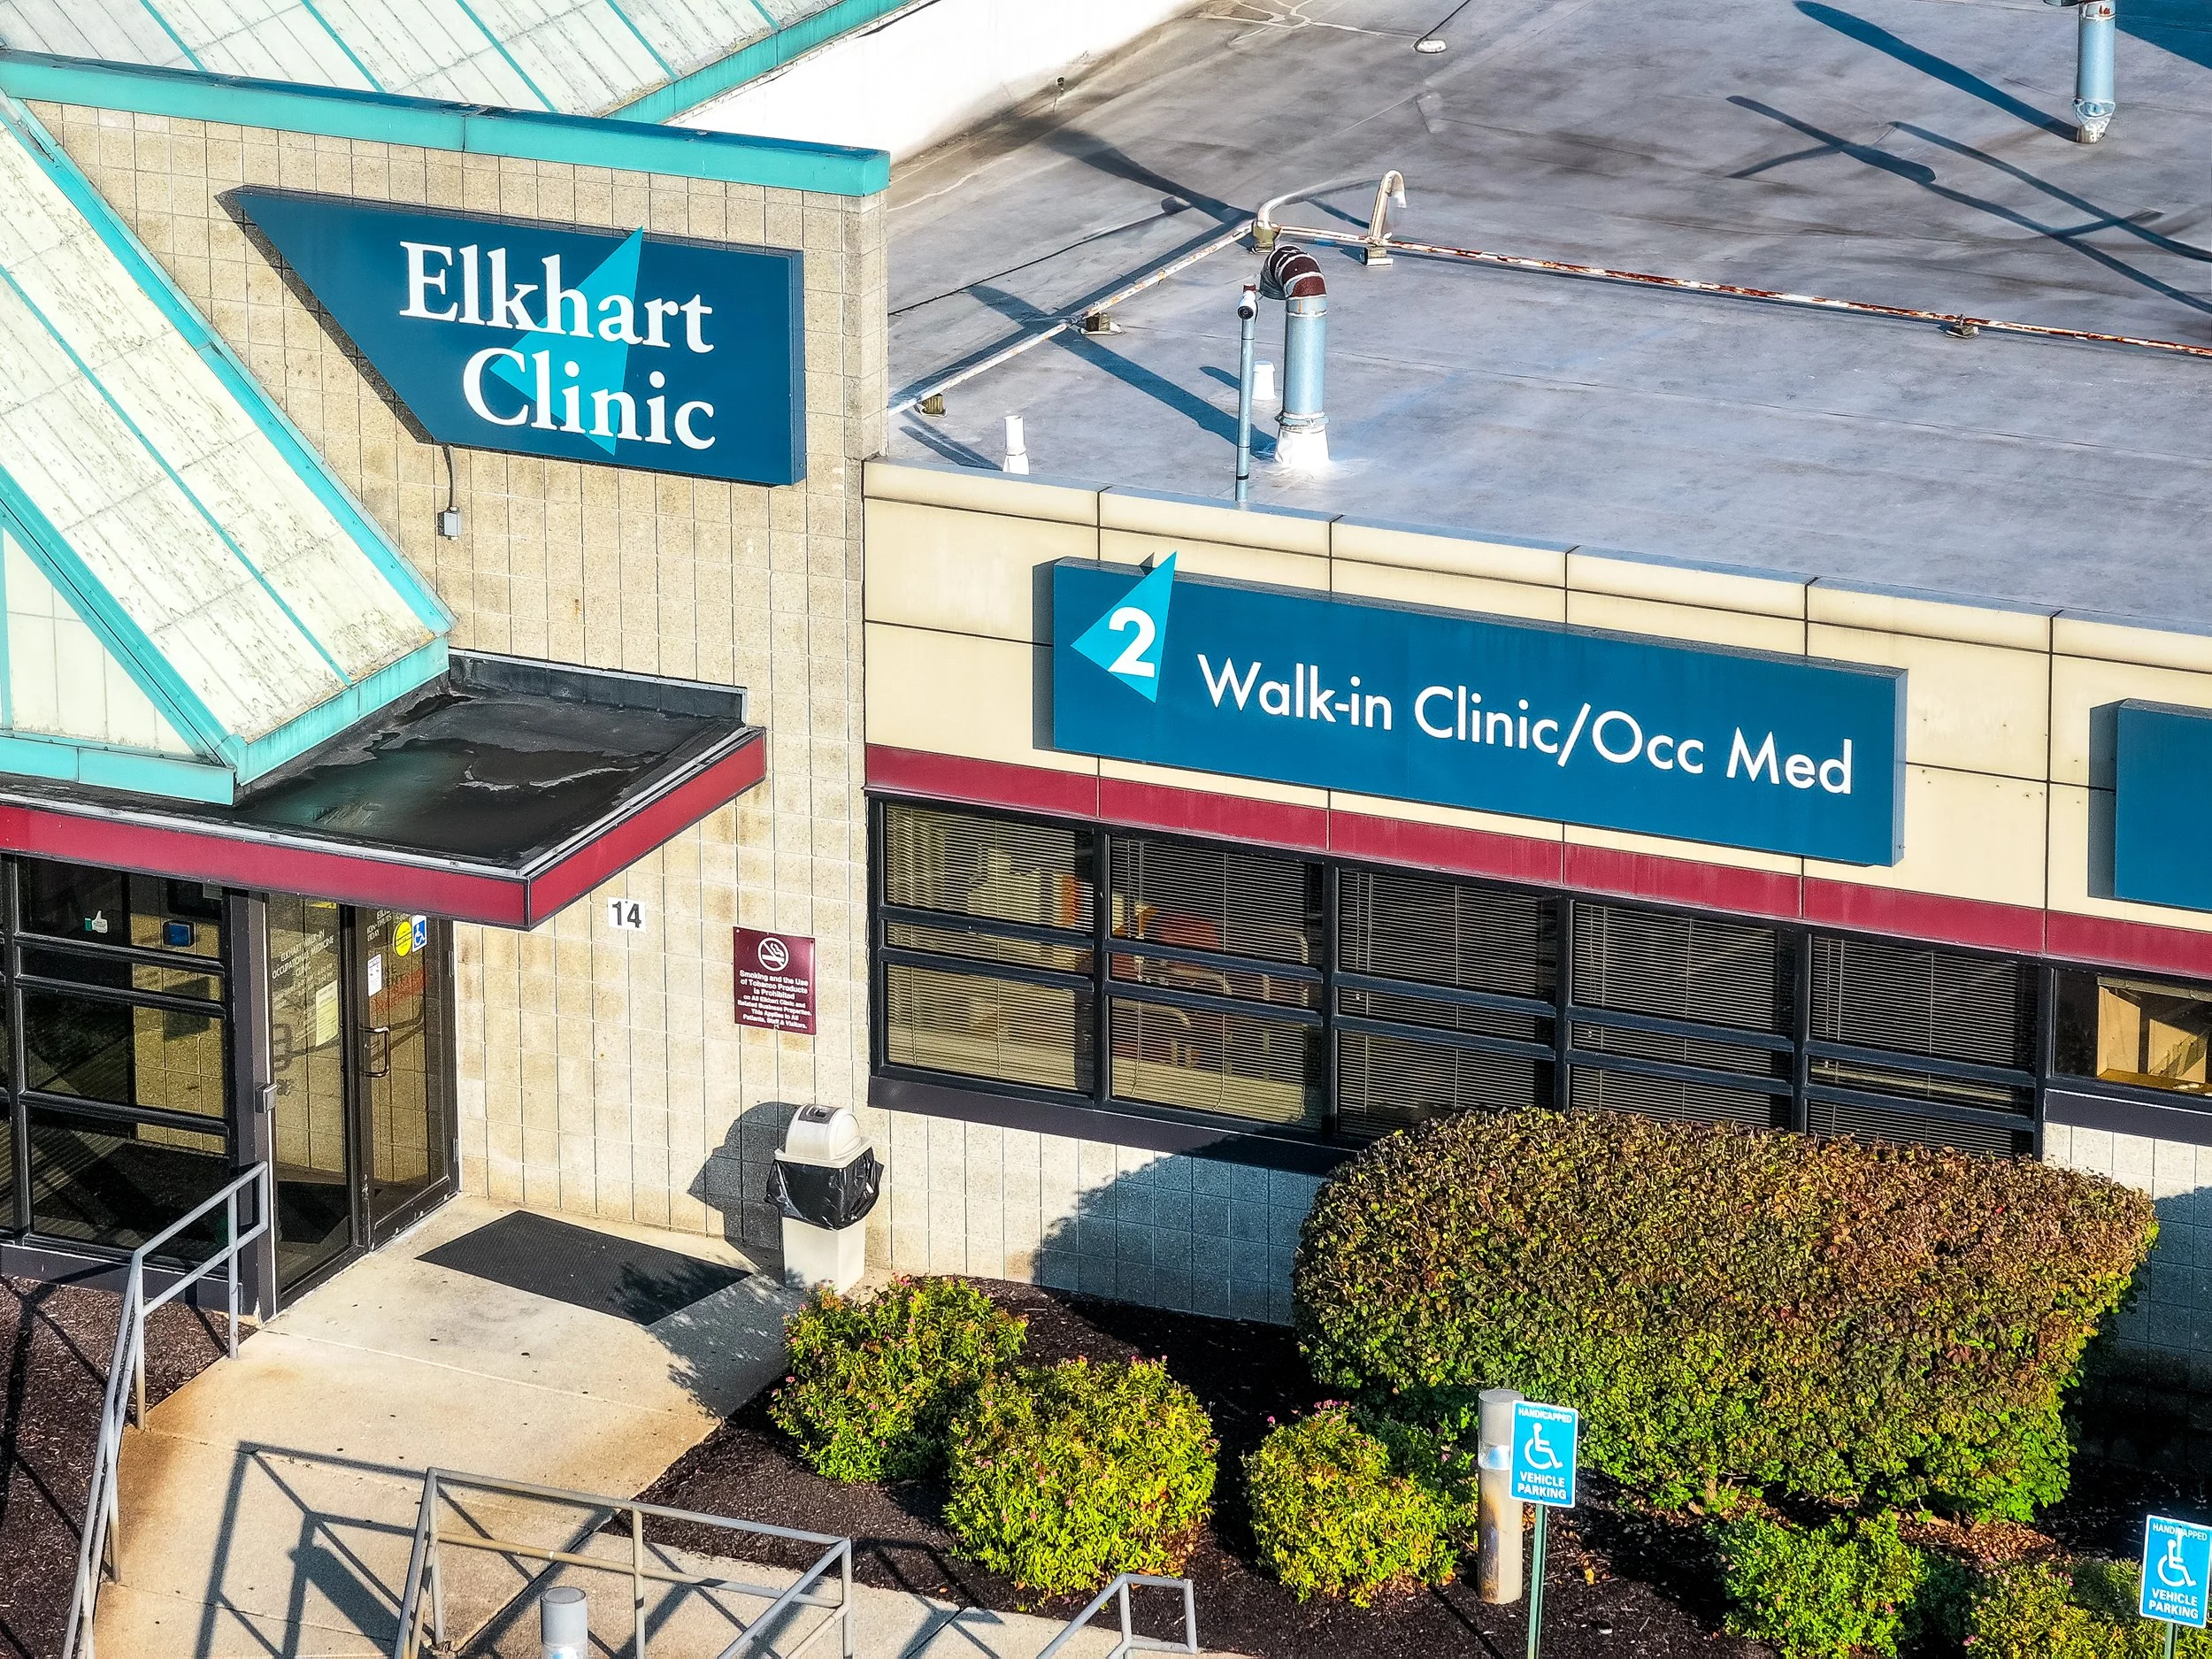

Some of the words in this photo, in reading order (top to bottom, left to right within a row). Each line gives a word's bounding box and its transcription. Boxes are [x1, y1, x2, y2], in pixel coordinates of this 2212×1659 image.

[398, 241, 715, 356] Elkhart
[462, 346, 717, 452] Clinic
[1108, 606, 1156, 678] 2
[1197, 653, 1394, 732] Walk-in
[1414, 684, 1704, 775] Clinic/Occ
[1726, 726, 1854, 795] Med
[611, 901, 642, 929] 14
[740, 970, 768, 982] Smoking
[795, 978, 809, 987] Use
[749, 979, 777, 989] Tobacco
[778, 984, 809, 995] Products
[761, 989, 795, 1000] Prohibited
[1518, 1407, 1573, 1424] HANDICAPPED
[1519, 1471, 1565, 1488] VEHICLE
[1517, 1483, 1567, 1500] PARKING
[2152, 1588, 2199, 1607] VEHICLE
[2148, 1599, 2200, 1620] PARKING
